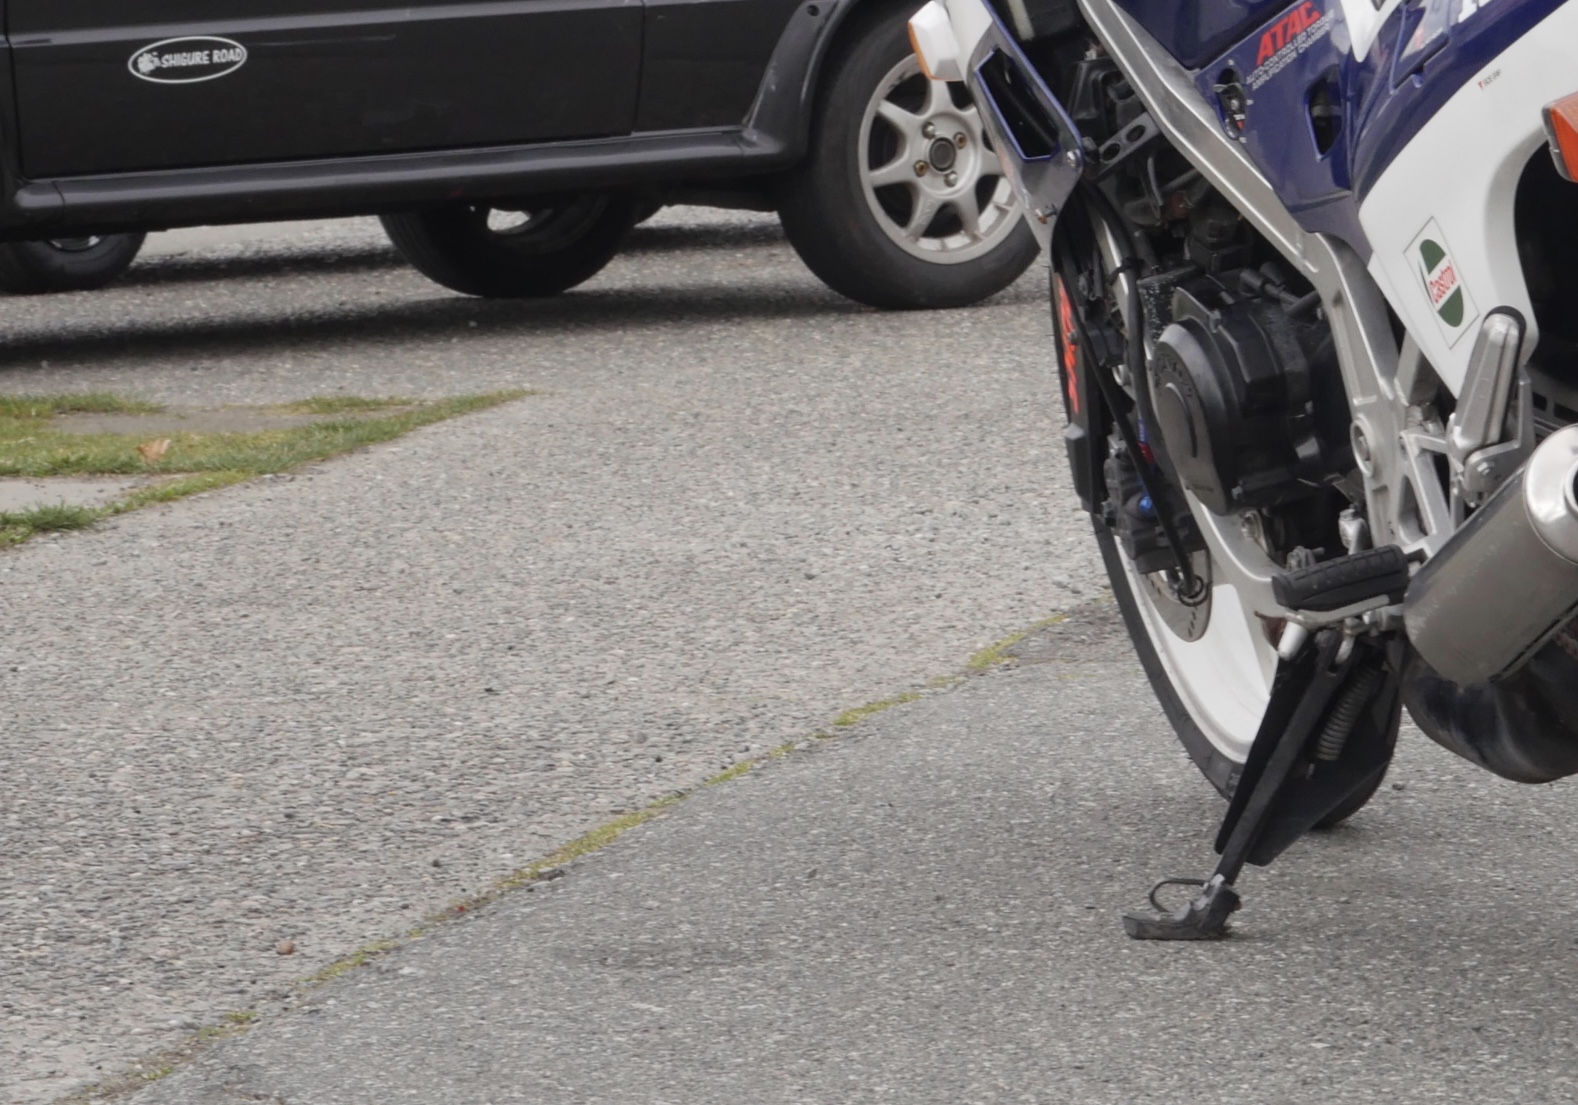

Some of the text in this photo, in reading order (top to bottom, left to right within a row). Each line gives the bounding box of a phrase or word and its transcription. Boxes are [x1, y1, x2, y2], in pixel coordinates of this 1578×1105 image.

[1256, 0, 1322, 66] ATAC
[161, 48, 243, 68] SHIGURE ROAD
